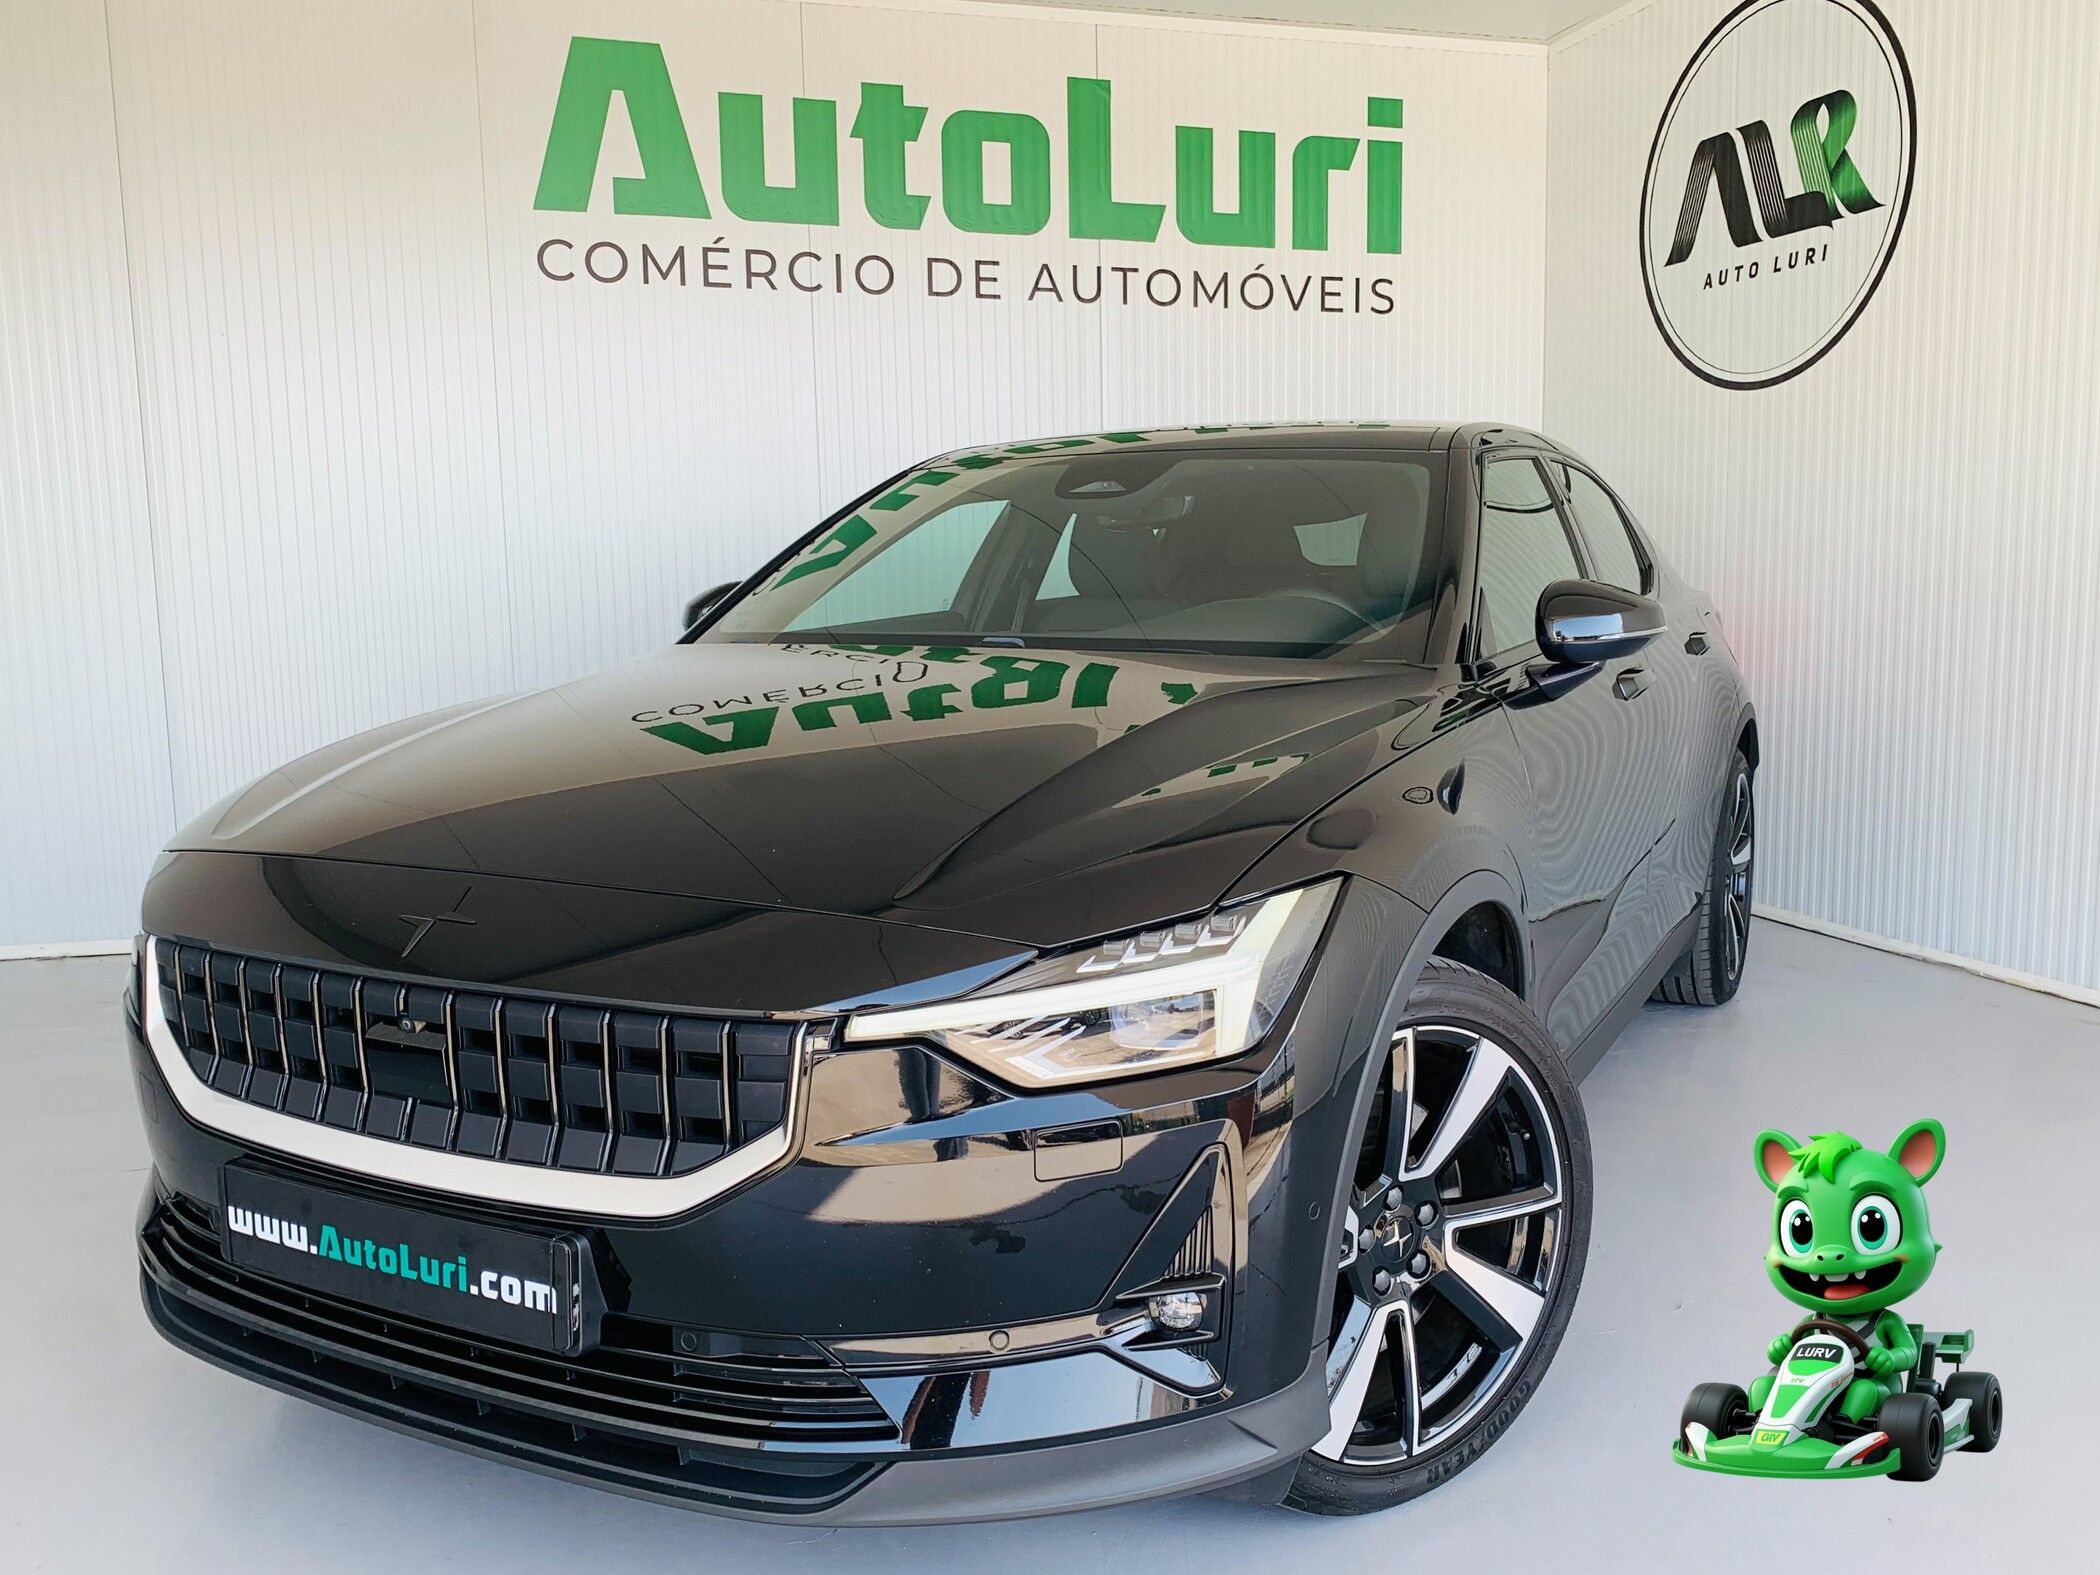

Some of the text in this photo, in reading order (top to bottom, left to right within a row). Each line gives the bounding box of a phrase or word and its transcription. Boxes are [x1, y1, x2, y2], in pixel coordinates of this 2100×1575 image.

[533, 37, 1404, 254] AutoLuri
[536, 236, 1395, 316] COMÉRCIO DE AUTOMÓVEIS
[1703, 243, 1829, 290] AUTO LURI
[227, 1205, 558, 1315] www.AutoLuri.com
